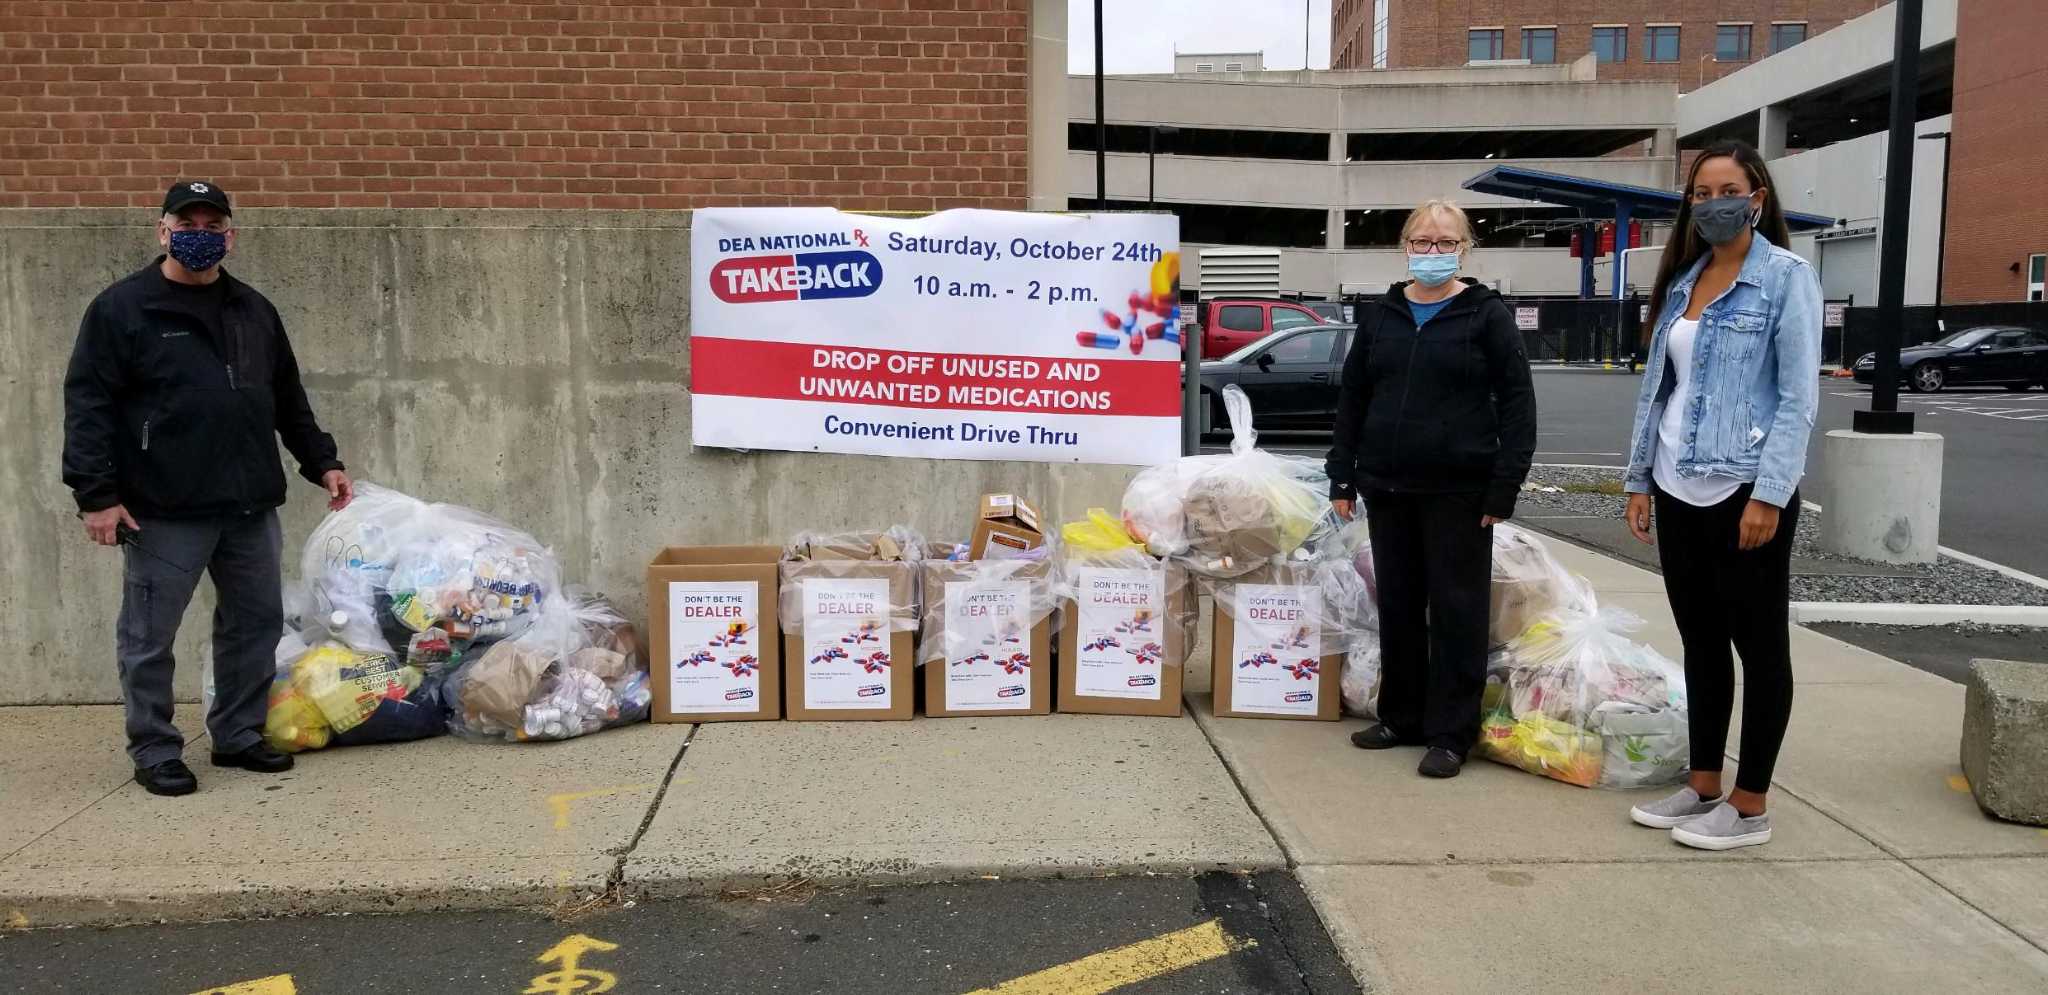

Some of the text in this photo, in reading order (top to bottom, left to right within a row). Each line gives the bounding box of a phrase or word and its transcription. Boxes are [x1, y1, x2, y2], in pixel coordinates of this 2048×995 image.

[719, 238, 755, 252] DEA
[760, 232, 850, 250] NATIONAL
[888, 232, 1162, 262] Saturday, October 24th
[914, 275, 940, 296] 10
[948, 282, 997, 298] a.m.
[1027, 281, 1041, 300] 2
[1049, 285, 1098, 305] p.m.
[813, 349, 1101, 382] DROP OFF UNUSED AND
[800, 376, 1111, 410] UNWANTED MEDICATIONS
[824, 415, 1078, 445] Convenient Drive Thru
[1094, 581, 1119, 589] DON'T
[818, 602, 874, 614] DEALER
[1093, 592, 1149, 604] DEALER
[685, 606, 742, 617] DEALER
[1249, 608, 1304, 620] DEALER
